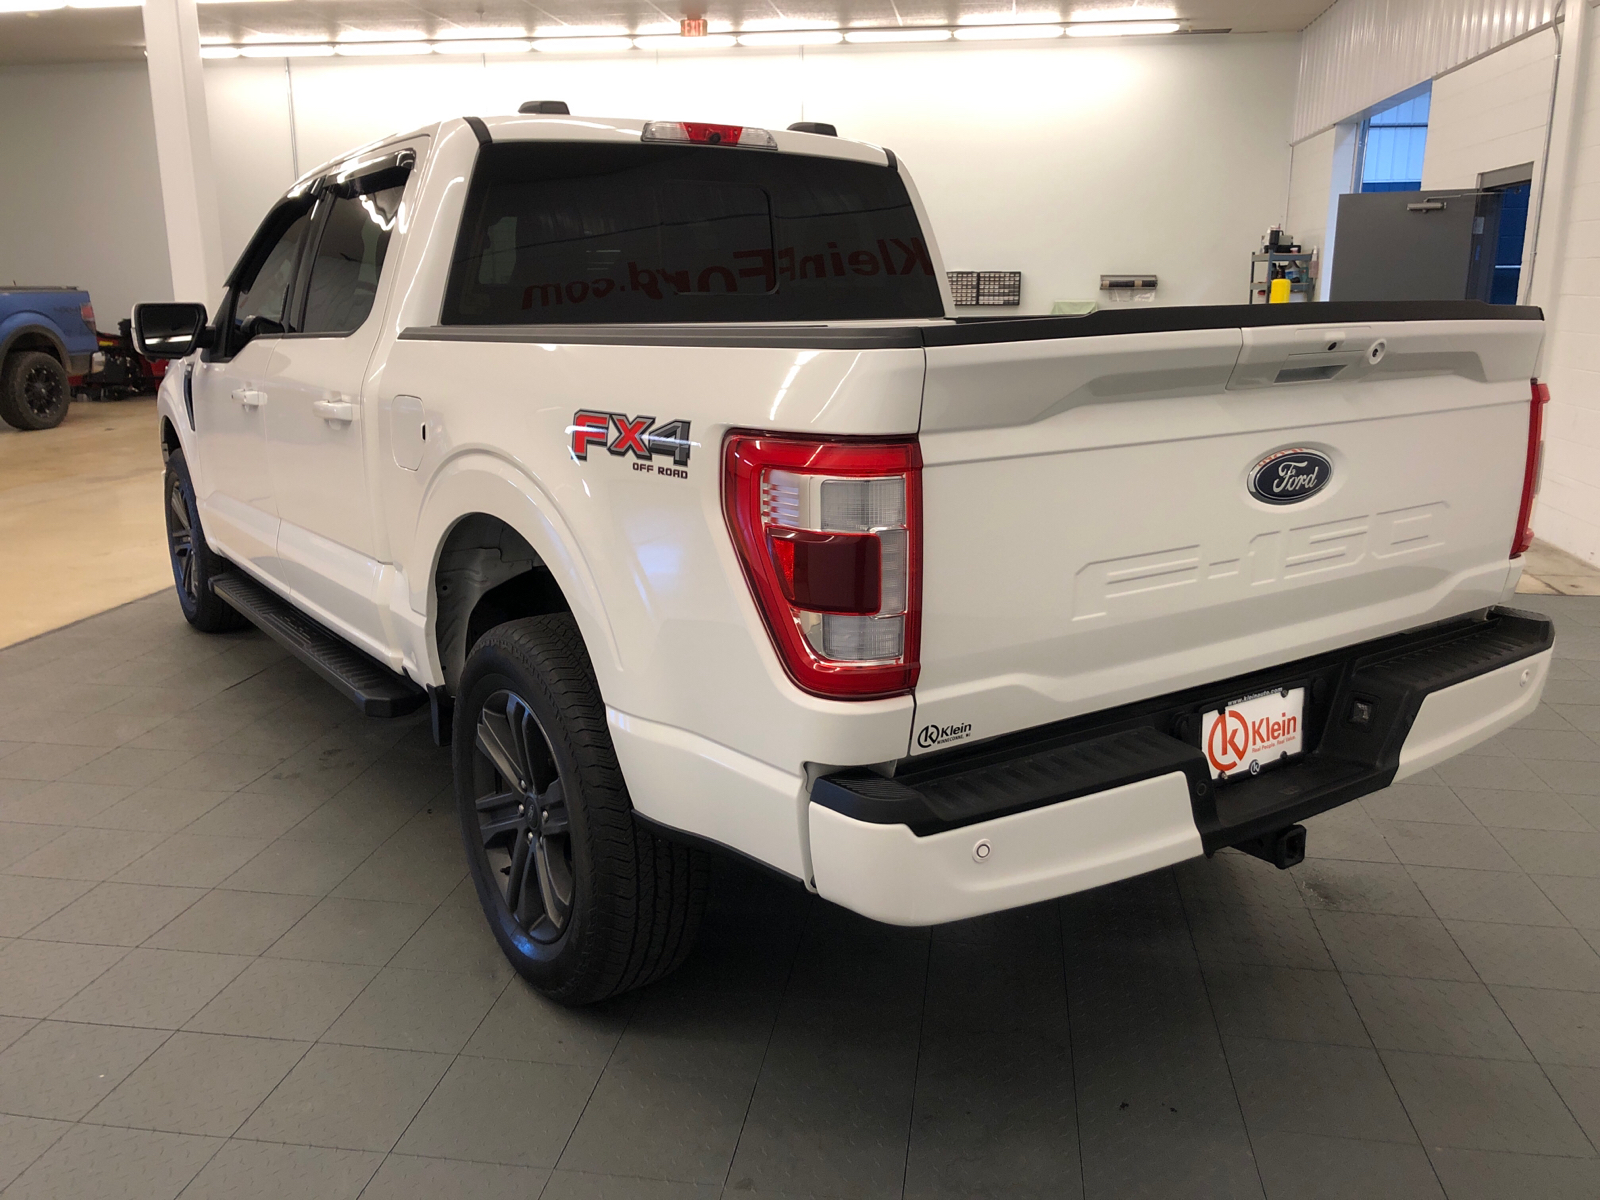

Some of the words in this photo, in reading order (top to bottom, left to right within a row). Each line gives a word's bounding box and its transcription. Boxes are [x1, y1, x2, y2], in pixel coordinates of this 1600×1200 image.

[684, 20, 704, 37] EXIT
[570, 408, 692, 468] FX4
[632, 462, 654, 473] OFF
[657, 466, 688, 479] ROAD
[1272, 460, 1319, 493] Ford
[940, 722, 972, 738] Klein
[1251, 711, 1297, 746] Klein
